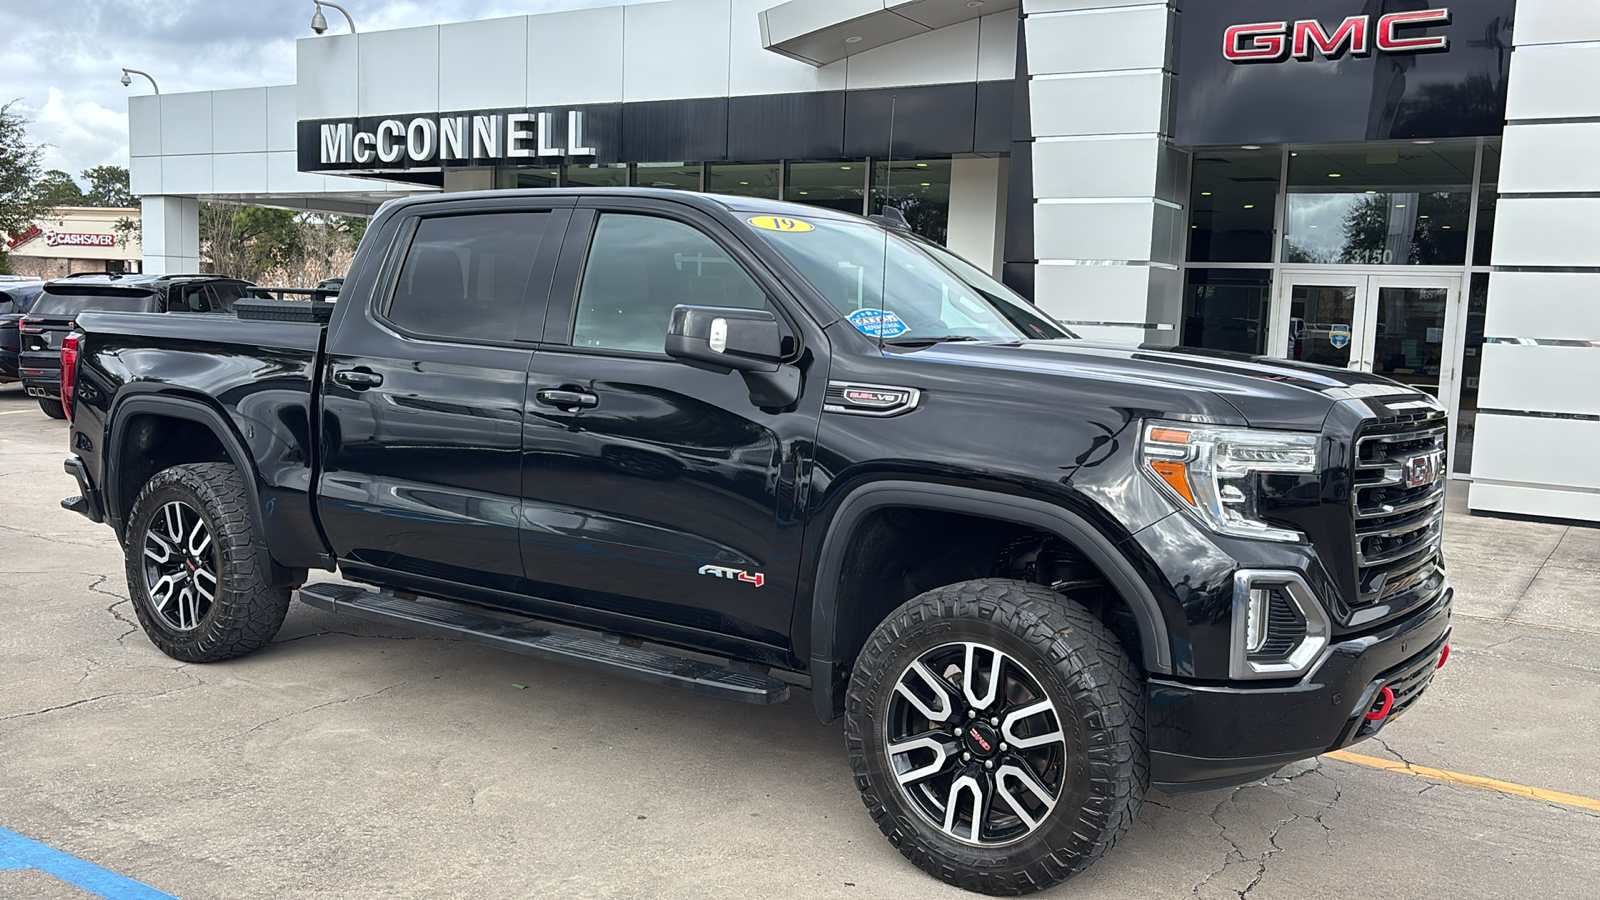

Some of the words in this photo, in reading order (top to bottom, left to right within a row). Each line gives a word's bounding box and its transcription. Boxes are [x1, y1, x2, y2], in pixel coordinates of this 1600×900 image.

[1223, 8, 1450, 62] GMC
[320, 110, 597, 164] McCONNELL
[57, 234, 113, 245] CASHSAVER
[1350, 249, 1393, 264] 3150
[698, 564, 764, 587] AT4
